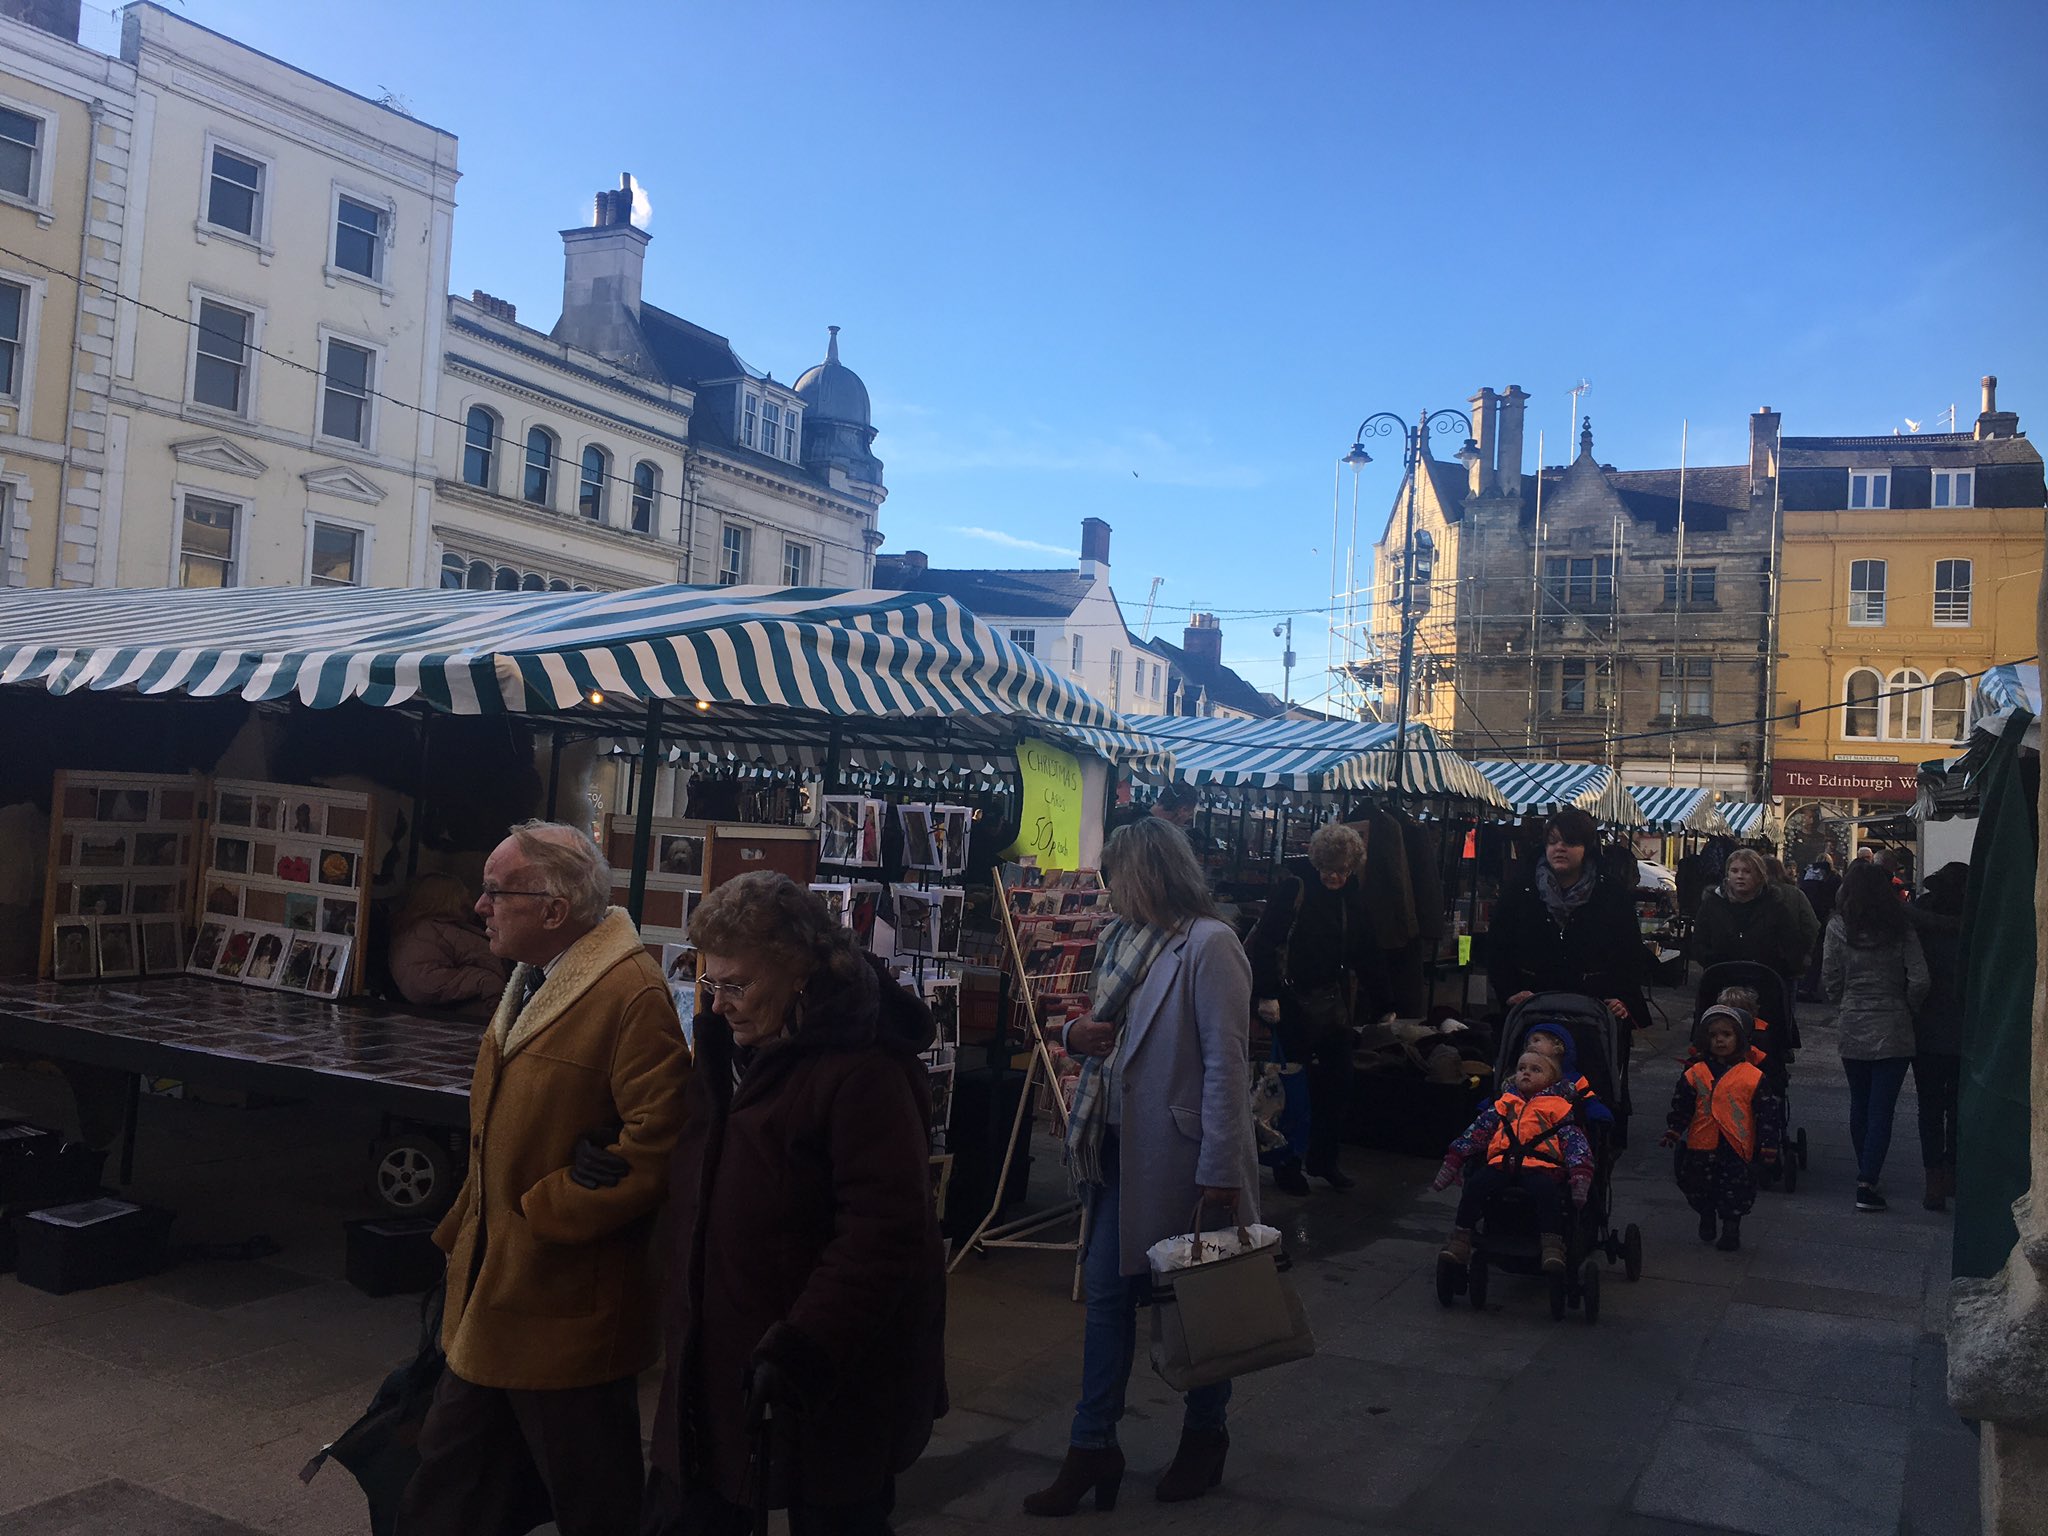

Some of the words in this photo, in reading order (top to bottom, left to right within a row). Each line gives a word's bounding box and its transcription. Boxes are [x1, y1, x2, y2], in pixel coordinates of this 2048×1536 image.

[1027, 750, 1077, 790] CHRISTMAS
[1786, 772, 1813, 786] The
[1818, 774, 1892, 791] Edinburgh
[1030, 817, 1057, 857] 50p
